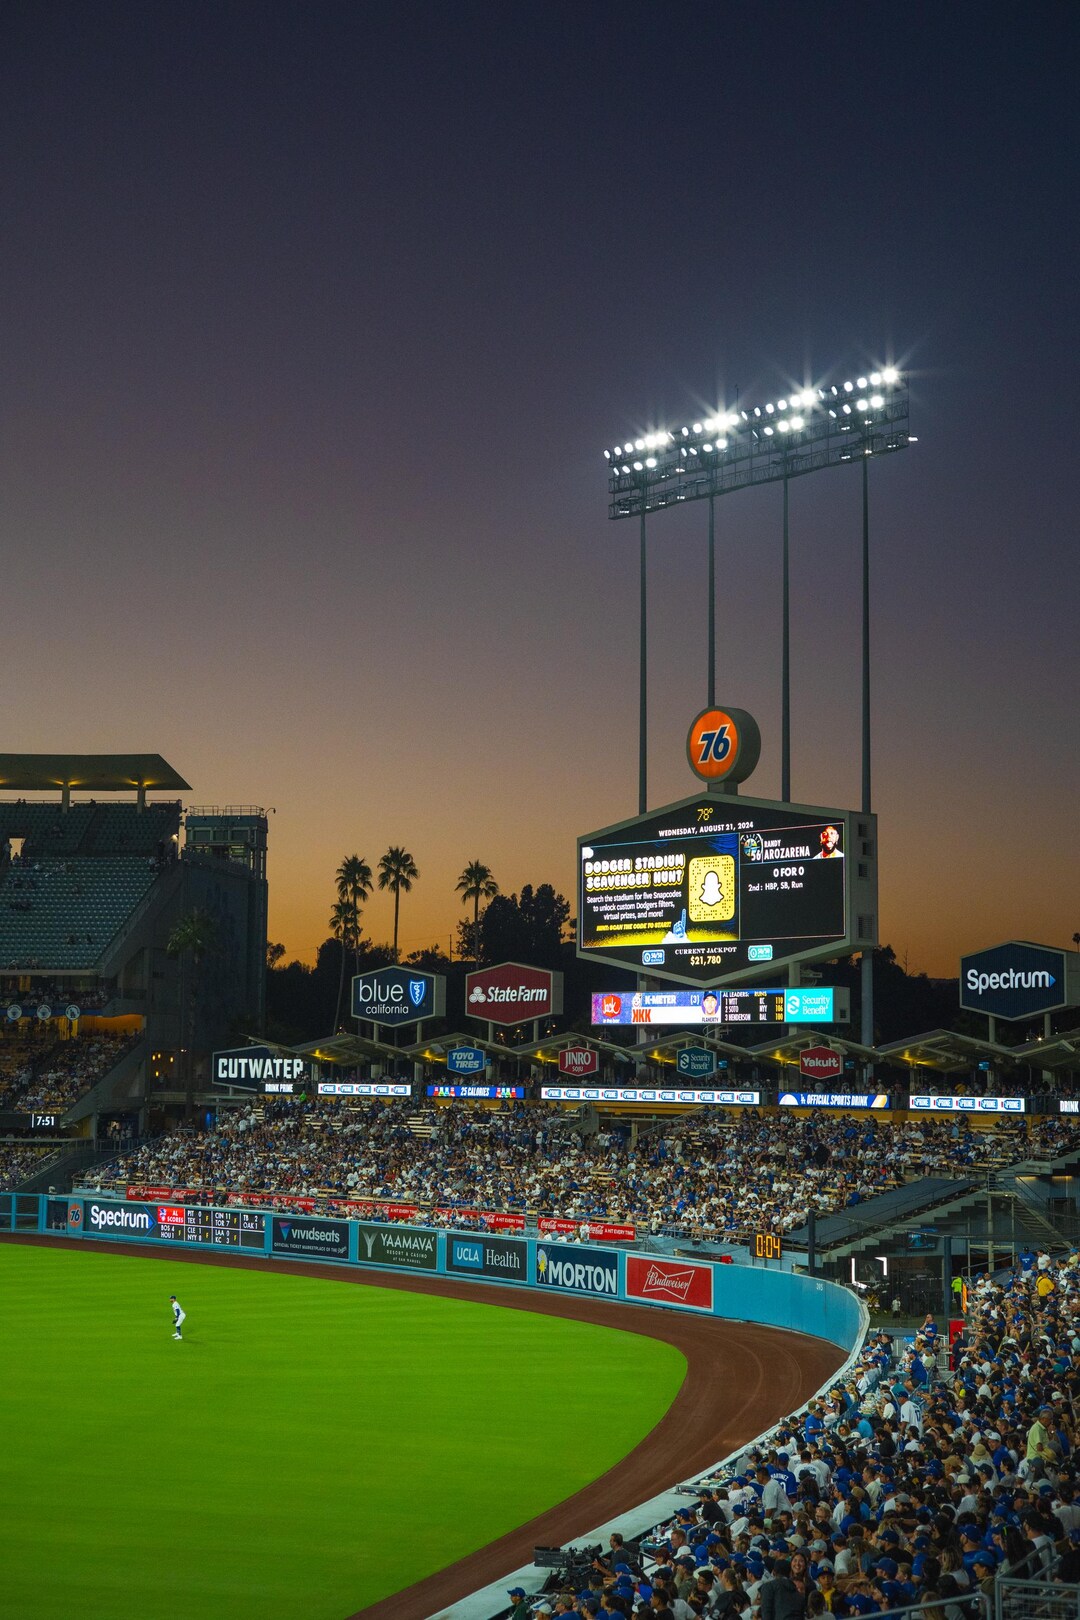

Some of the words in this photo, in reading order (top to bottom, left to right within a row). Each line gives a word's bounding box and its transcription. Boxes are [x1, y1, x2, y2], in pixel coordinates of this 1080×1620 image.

[698, 724, 732, 764] 76
[659, 827, 698, 838] WEDNESDAY,
[700, 824, 725, 835] AUGUST
[726, 823, 736, 834] 21,
[738, 821, 754, 832] 2024
[764, 840, 781, 848] RANDY
[751, 850, 761, 861] 56
[764, 846, 810, 860] AROZARENA
[585, 859, 632, 876] DODGER
[634, 854, 685, 871] STADIUM
[773, 868, 779, 877] 0
[780, 867, 798, 877] FOR
[798, 866, 804, 876] 0
[586, 873, 650, 890] SCAVENGER
[653, 870, 684, 886] HUNT
[765, 883, 779, 892] HBP,
[781, 883, 790, 891] SB,
[653, 890, 682, 900] Snapcodes
[636, 902, 658, 910] Dodgers
[658, 900, 675, 909] filters,
[620, 912, 636, 921] prizes,
[690, 955, 722, 966] $21,780
[967, 968, 1050, 995] Spectrum
[360, 979, 403, 1002] blue
[645, 995, 676, 1004] K-METER
[802, 995, 830, 1006] Security
[366, 1004, 408, 1014] california
[802, 1006, 826, 1015] Benefit
[564, 1052, 591, 1069] JINRO
[691, 1054, 710, 1063] Security
[802, 1057, 838, 1068] Yakult
[218, 1058, 304, 1079] CUTWATER
[461, 1087, 467, 1096] 25
[467, 1087, 490, 1096] CALORIES
[807, 1094, 829, 1105] OFFICIAL
[830, 1095, 850, 1106] SPORTS
[851, 1095, 868, 1106] DRINK
[1060, 1101, 1079, 1112] DRINK
[37, 1116, 54, 1126] 7:51
[70, 1208, 81, 1223] 76
[91, 1206, 149, 1229] Spectrum
[291, 1226, 340, 1243] vividseats
[381, 1233, 434, 1252] YAAMAVA'
[756, 1234, 780, 1258] 0:04
[456, 1247, 479, 1262] UCLA
[486, 1249, 520, 1269] Health
[549, 1261, 617, 1293] MORTON
[647, 1271, 689, 1290] Budweiser
